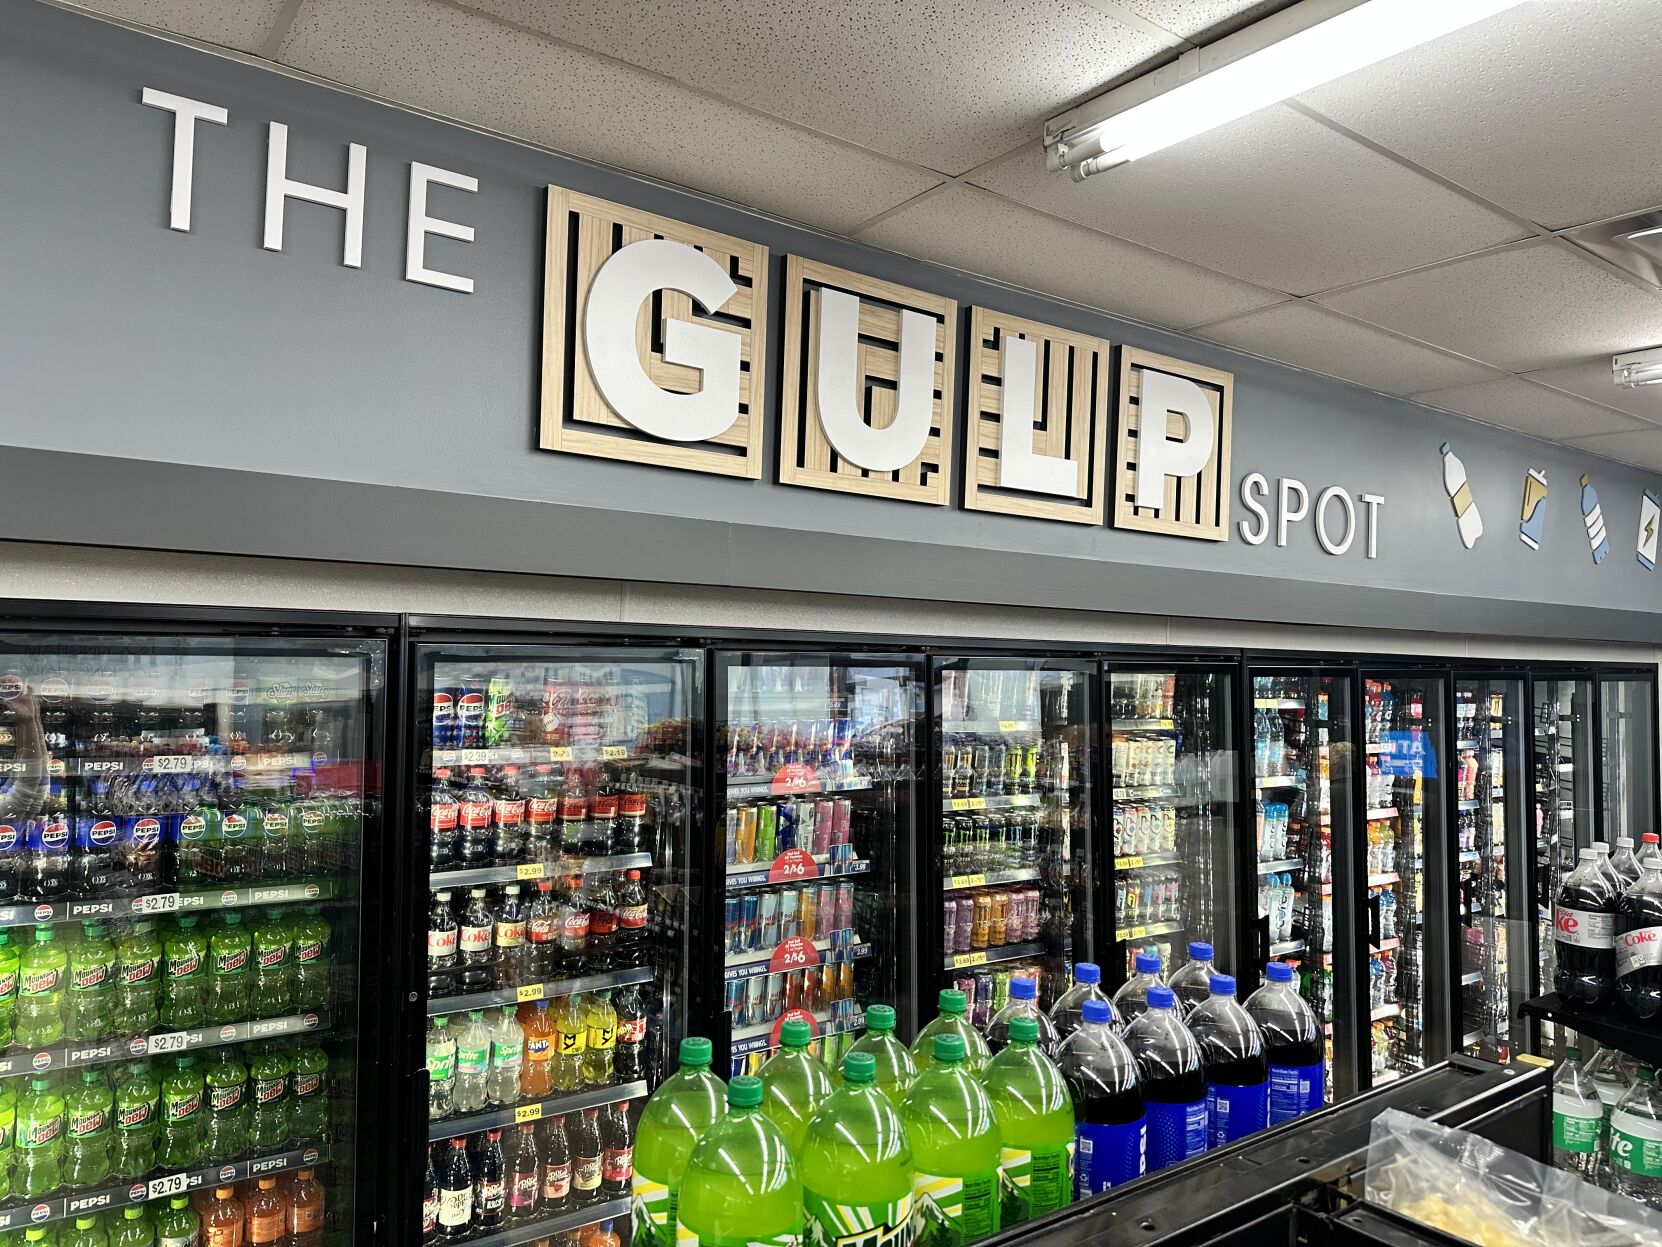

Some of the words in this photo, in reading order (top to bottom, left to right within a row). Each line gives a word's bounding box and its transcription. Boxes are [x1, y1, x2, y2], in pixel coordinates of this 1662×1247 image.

[142, 87, 479, 293] THE
[585, 239, 1214, 509] GULP
[1238, 472, 1385, 558] SPOT
[263, 757, 297, 766] PEPSI
[464, 752, 487, 762] $2.39
[0, 763, 26, 772] EPSI
[85, 761, 124, 770] PEPSI
[158, 757, 187, 770] $2.79
[43, 831, 68, 839] PEPSI
[91, 829, 116, 837] PEPSI
[135, 826, 159, 835] PEPSI
[519, 867, 542, 875] $2.99
[783, 863, 805, 875] 2/$6
[255, 890, 289, 899] PEPSI
[145, 896, 175, 910] $2.79
[178, 896, 204, 907] EPSI
[73, 903, 113, 914] PEPSI
[1555, 909, 1578, 934] ke
[461, 929, 490, 942] Coke
[498, 925, 525, 938] Coke
[1624, 931, 1656, 946] Coke
[784, 952, 806, 964] 2/$6
[738, 969, 747, 977] YOU
[519, 987, 541, 997] $2.99
[254, 1021, 288, 1033] PEPSI
[154, 1035, 183, 1049] $2.79
[738, 1043, 748, 1051] YOU
[71, 1047, 111, 1061] PEPSI
[517, 1108, 540, 1118] $2.99
[253, 1158, 287, 1172] PEPSI
[152, 1178, 182, 1194] $2.79
[70, 1194, 110, 1212] PEPSI
